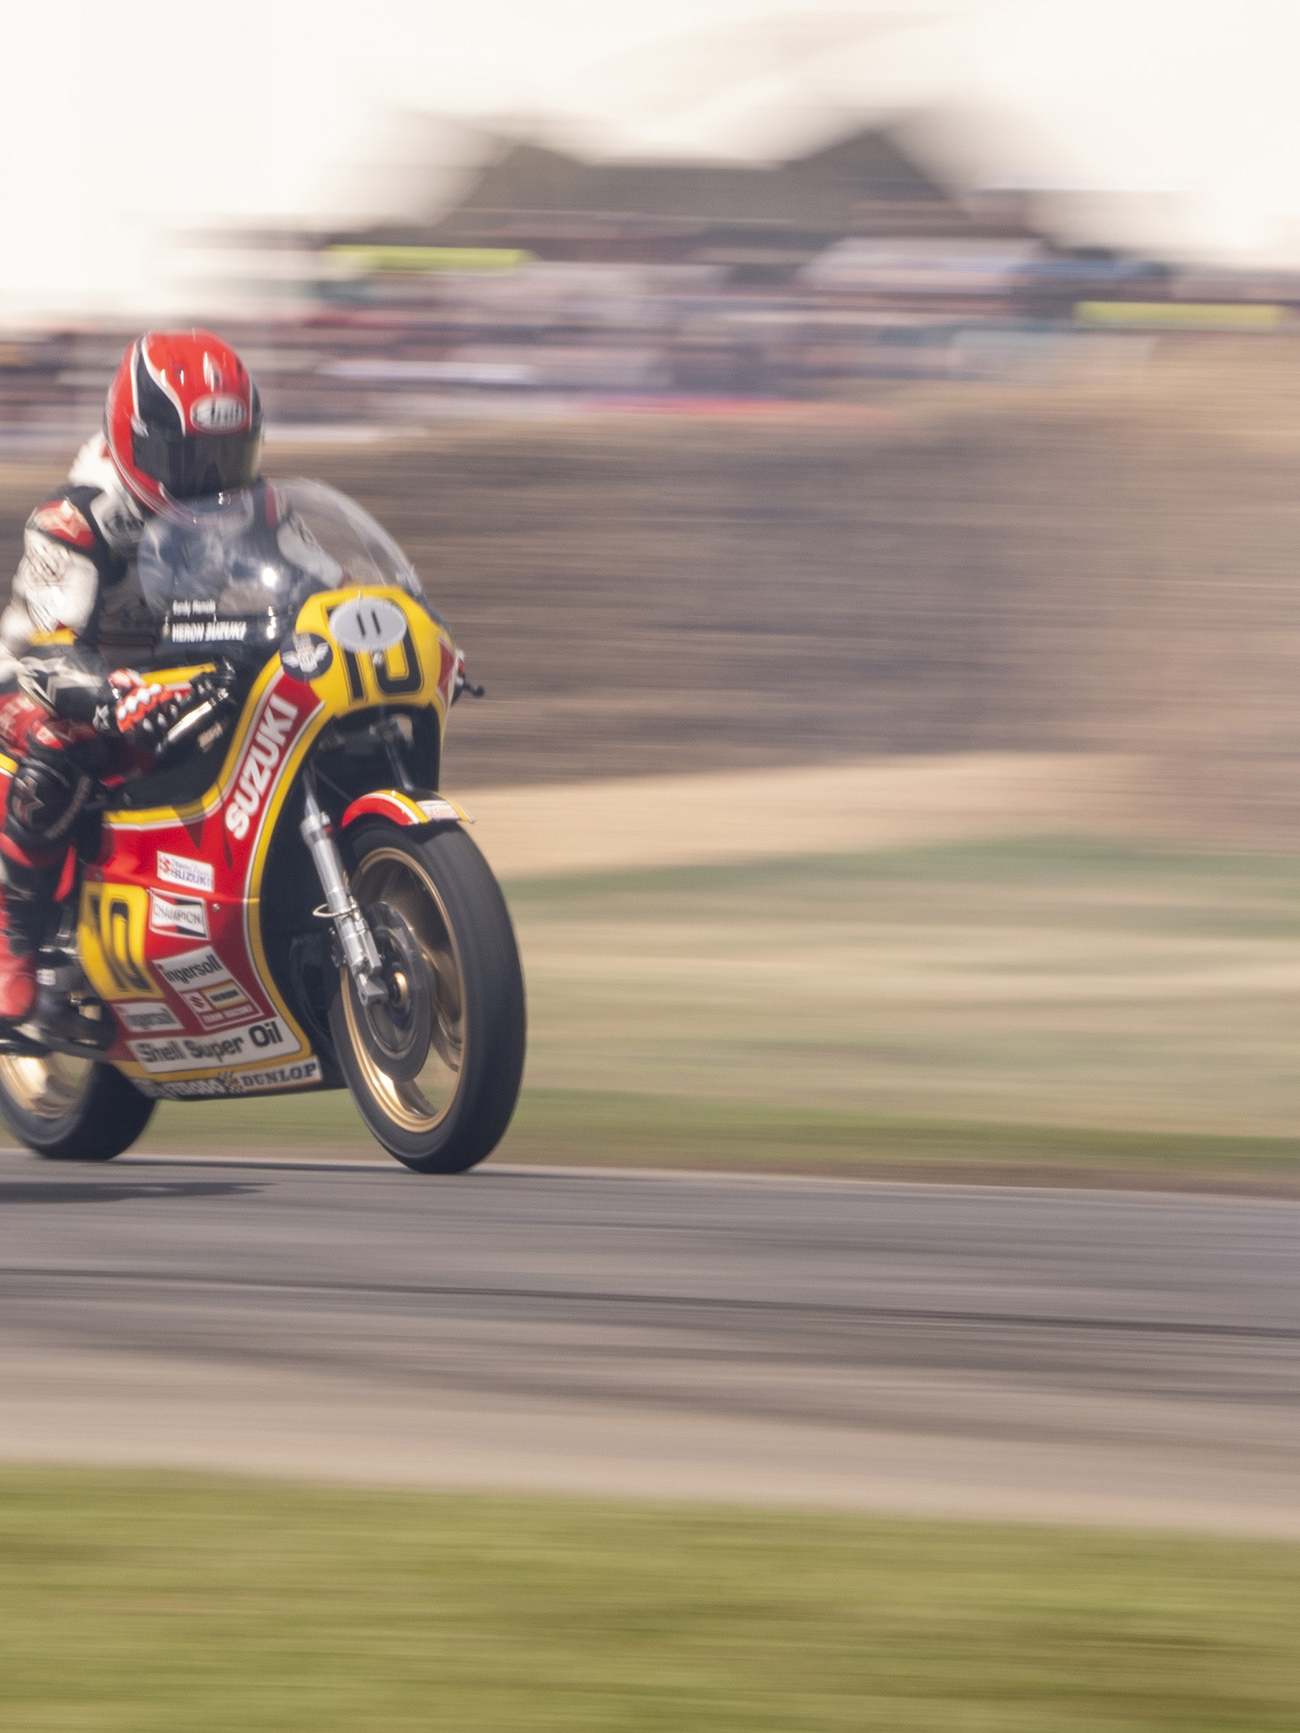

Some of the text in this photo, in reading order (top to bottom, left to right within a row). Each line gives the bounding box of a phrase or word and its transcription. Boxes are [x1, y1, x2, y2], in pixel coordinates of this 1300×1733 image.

[356, 609, 382, 638] 11
[225, 692, 299, 840] SUZUKI
[136, 1020, 283, 1063] Shell Super Oil
[241, 1063, 317, 1088] DUNLOP
